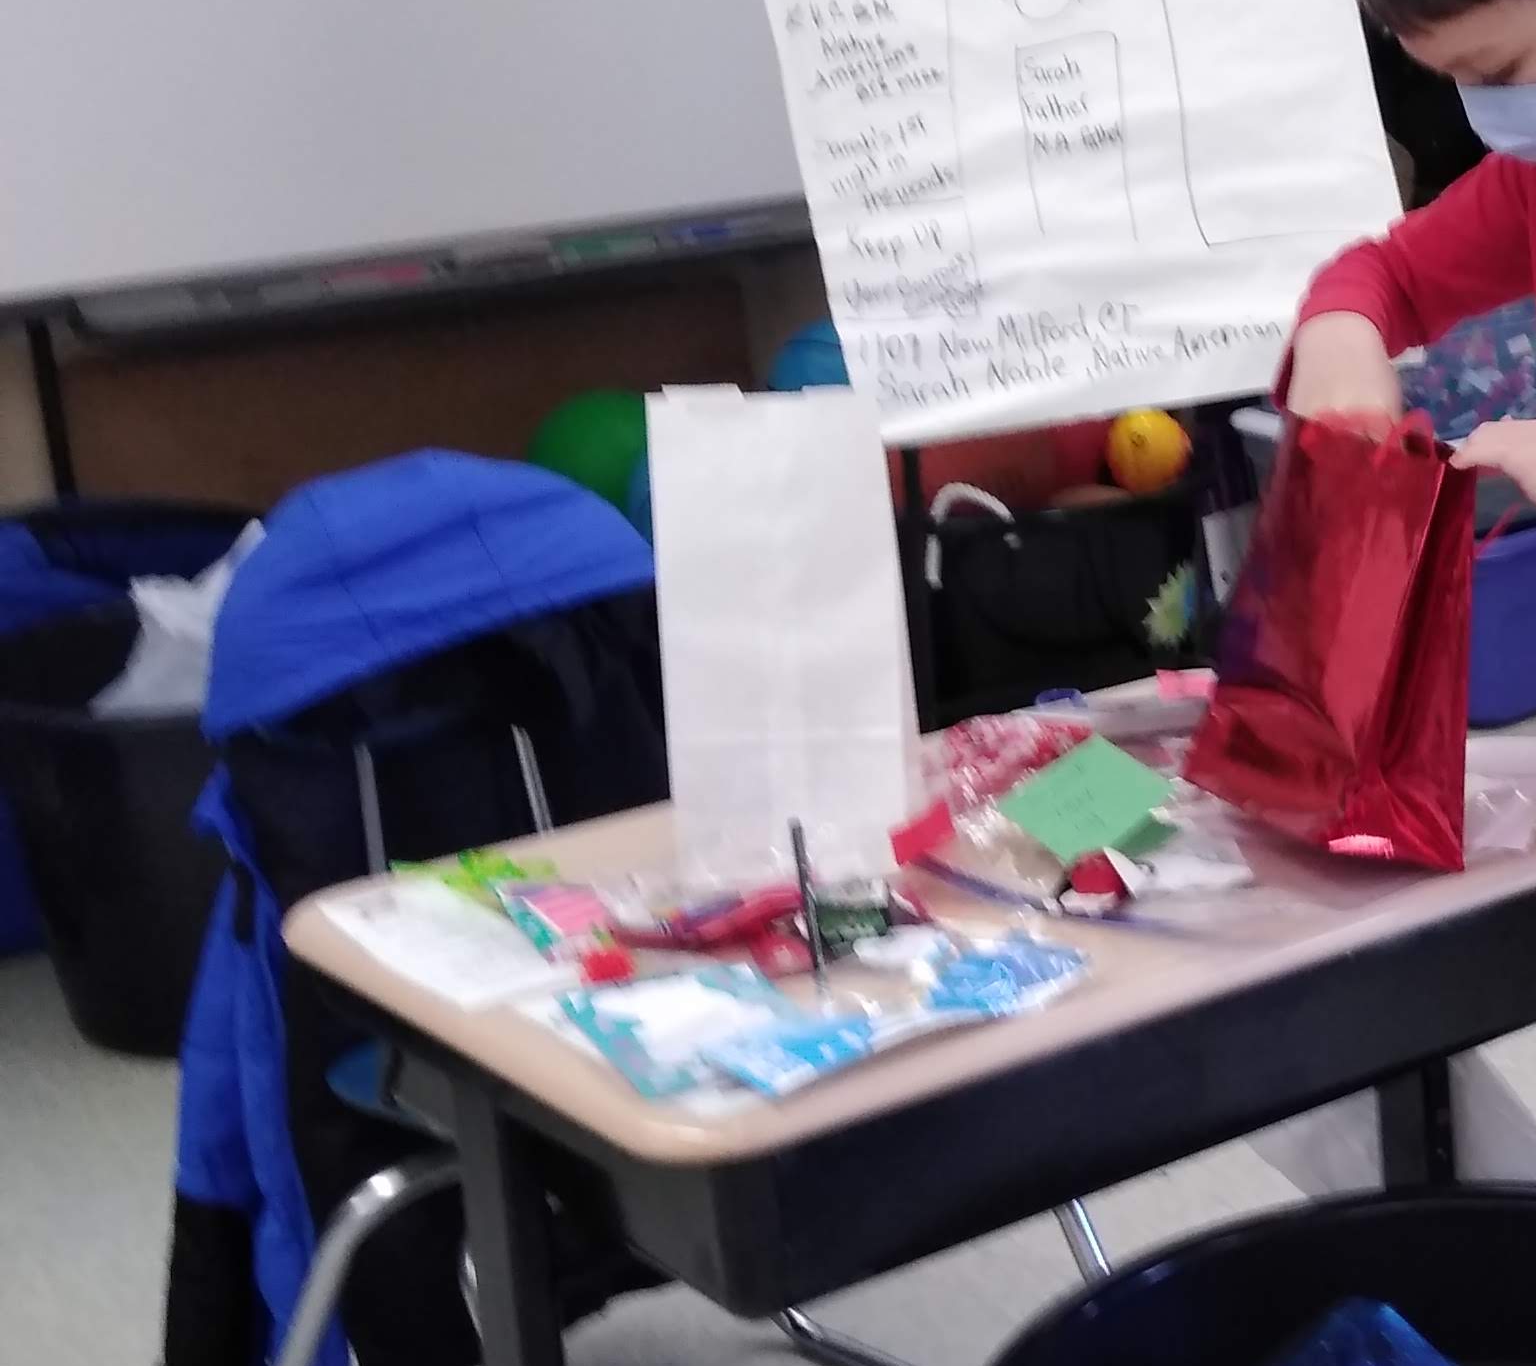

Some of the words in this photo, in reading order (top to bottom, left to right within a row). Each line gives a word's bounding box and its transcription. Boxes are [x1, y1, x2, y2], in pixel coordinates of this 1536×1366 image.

[1024, 52, 1082, 84] Sarah
[938, 329, 993, 359] New
[876, 367, 971, 409] Sarah
[1173, 320, 1283, 362] American
